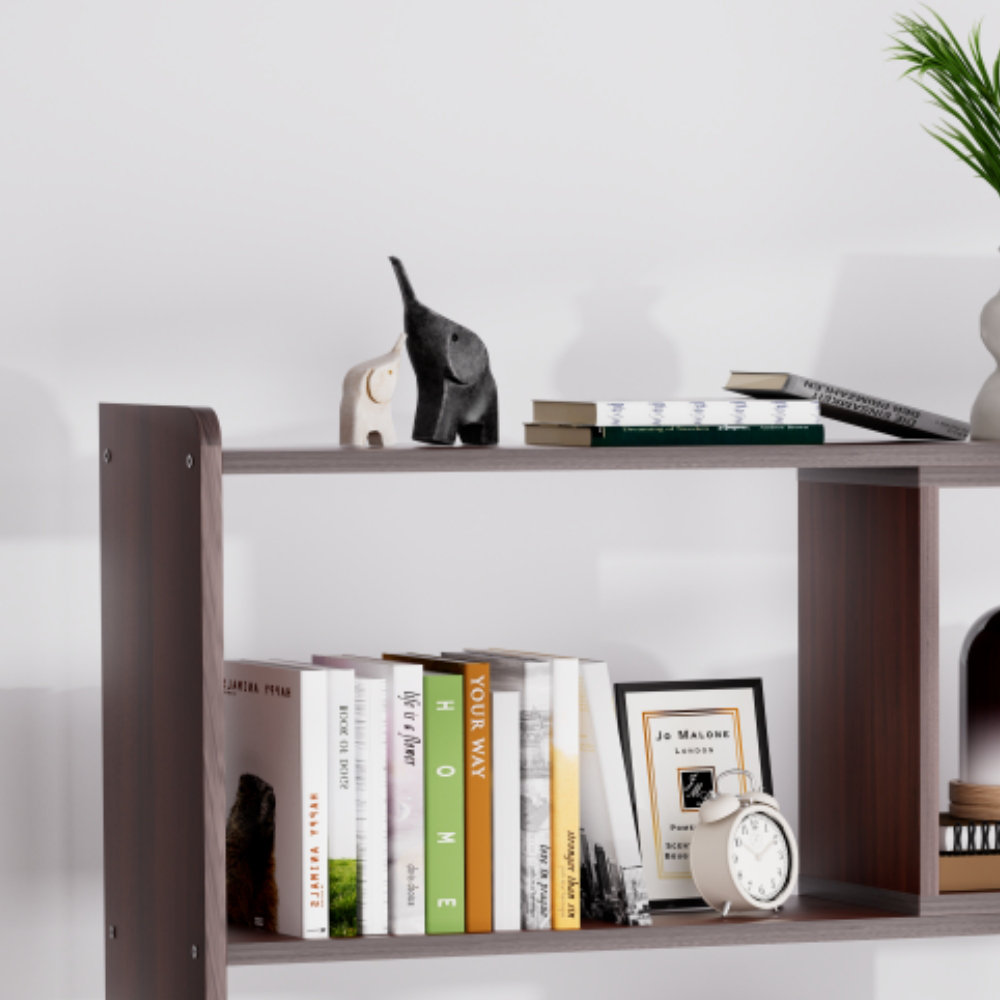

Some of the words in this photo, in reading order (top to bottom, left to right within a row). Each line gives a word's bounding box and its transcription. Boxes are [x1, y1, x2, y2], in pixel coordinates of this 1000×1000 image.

[469, 674, 487, 732] YOUR
[470, 736, 487, 780] WAY
[435, 700, 457, 908] HOME
